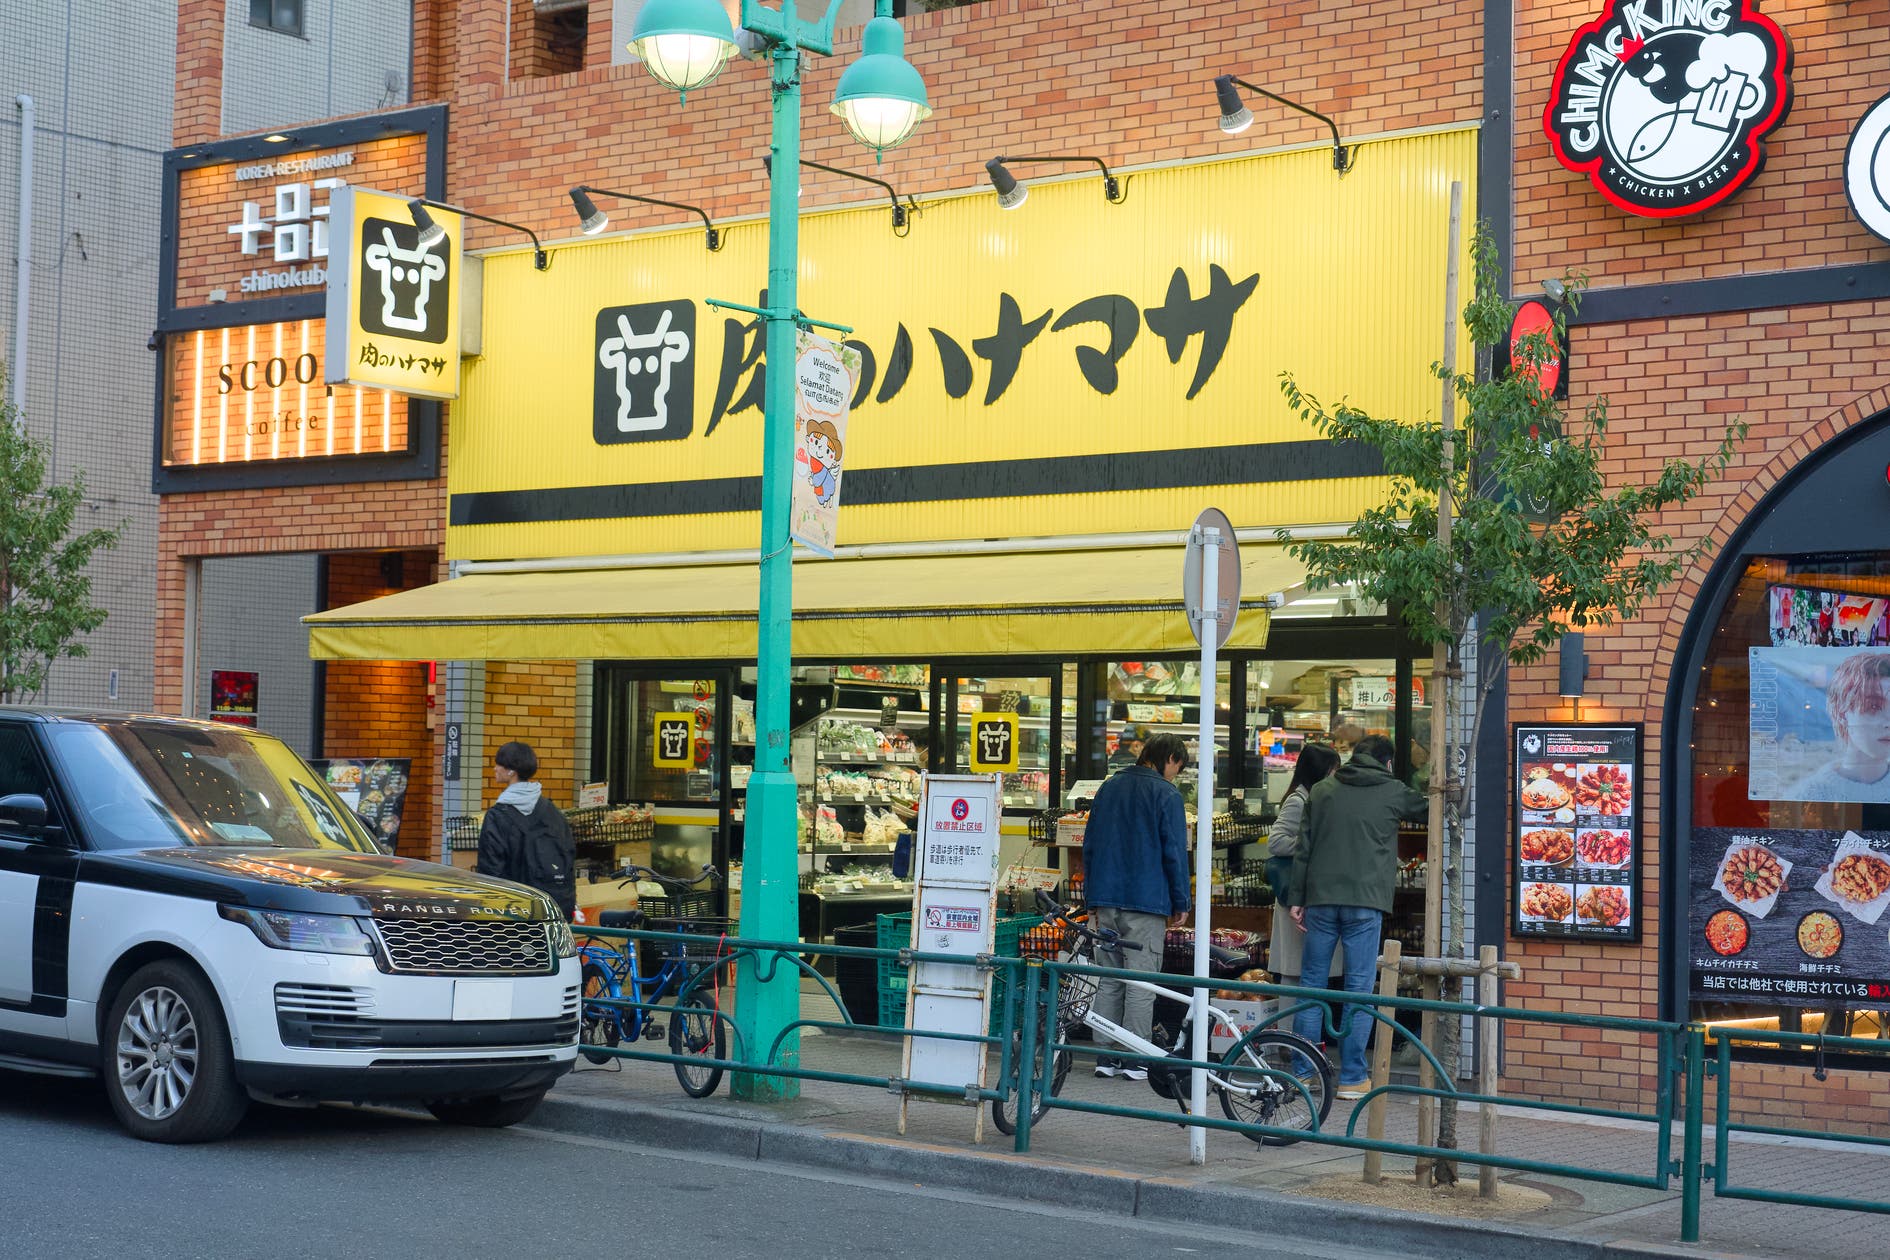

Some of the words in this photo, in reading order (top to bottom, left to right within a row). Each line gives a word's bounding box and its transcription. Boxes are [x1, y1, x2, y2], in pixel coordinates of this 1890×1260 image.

[235, 164, 275, 181] KOREA
[276, 151, 354, 176] RESTAURANT
[1618, 175, 1676, 198] CHICKEN
[1682, 185, 1691, 195] X
[1698, 164, 1730, 189] BEER
[240, 263, 330, 293] shinokub
[358, 341, 448, 378] 肉のハナマサ
[813, 357, 840, 374] Welcome
[800, 375, 825, 391] Selamat
[825, 385, 844, 402] Datang
[246, 410, 319, 437] coffee
[934, 820, 983, 832] 放置禁止区域
[1831, 837, 1890, 849] フライドチキン
[383, 903, 457, 914] RANGE
[470, 906, 532, 915] ROVER
